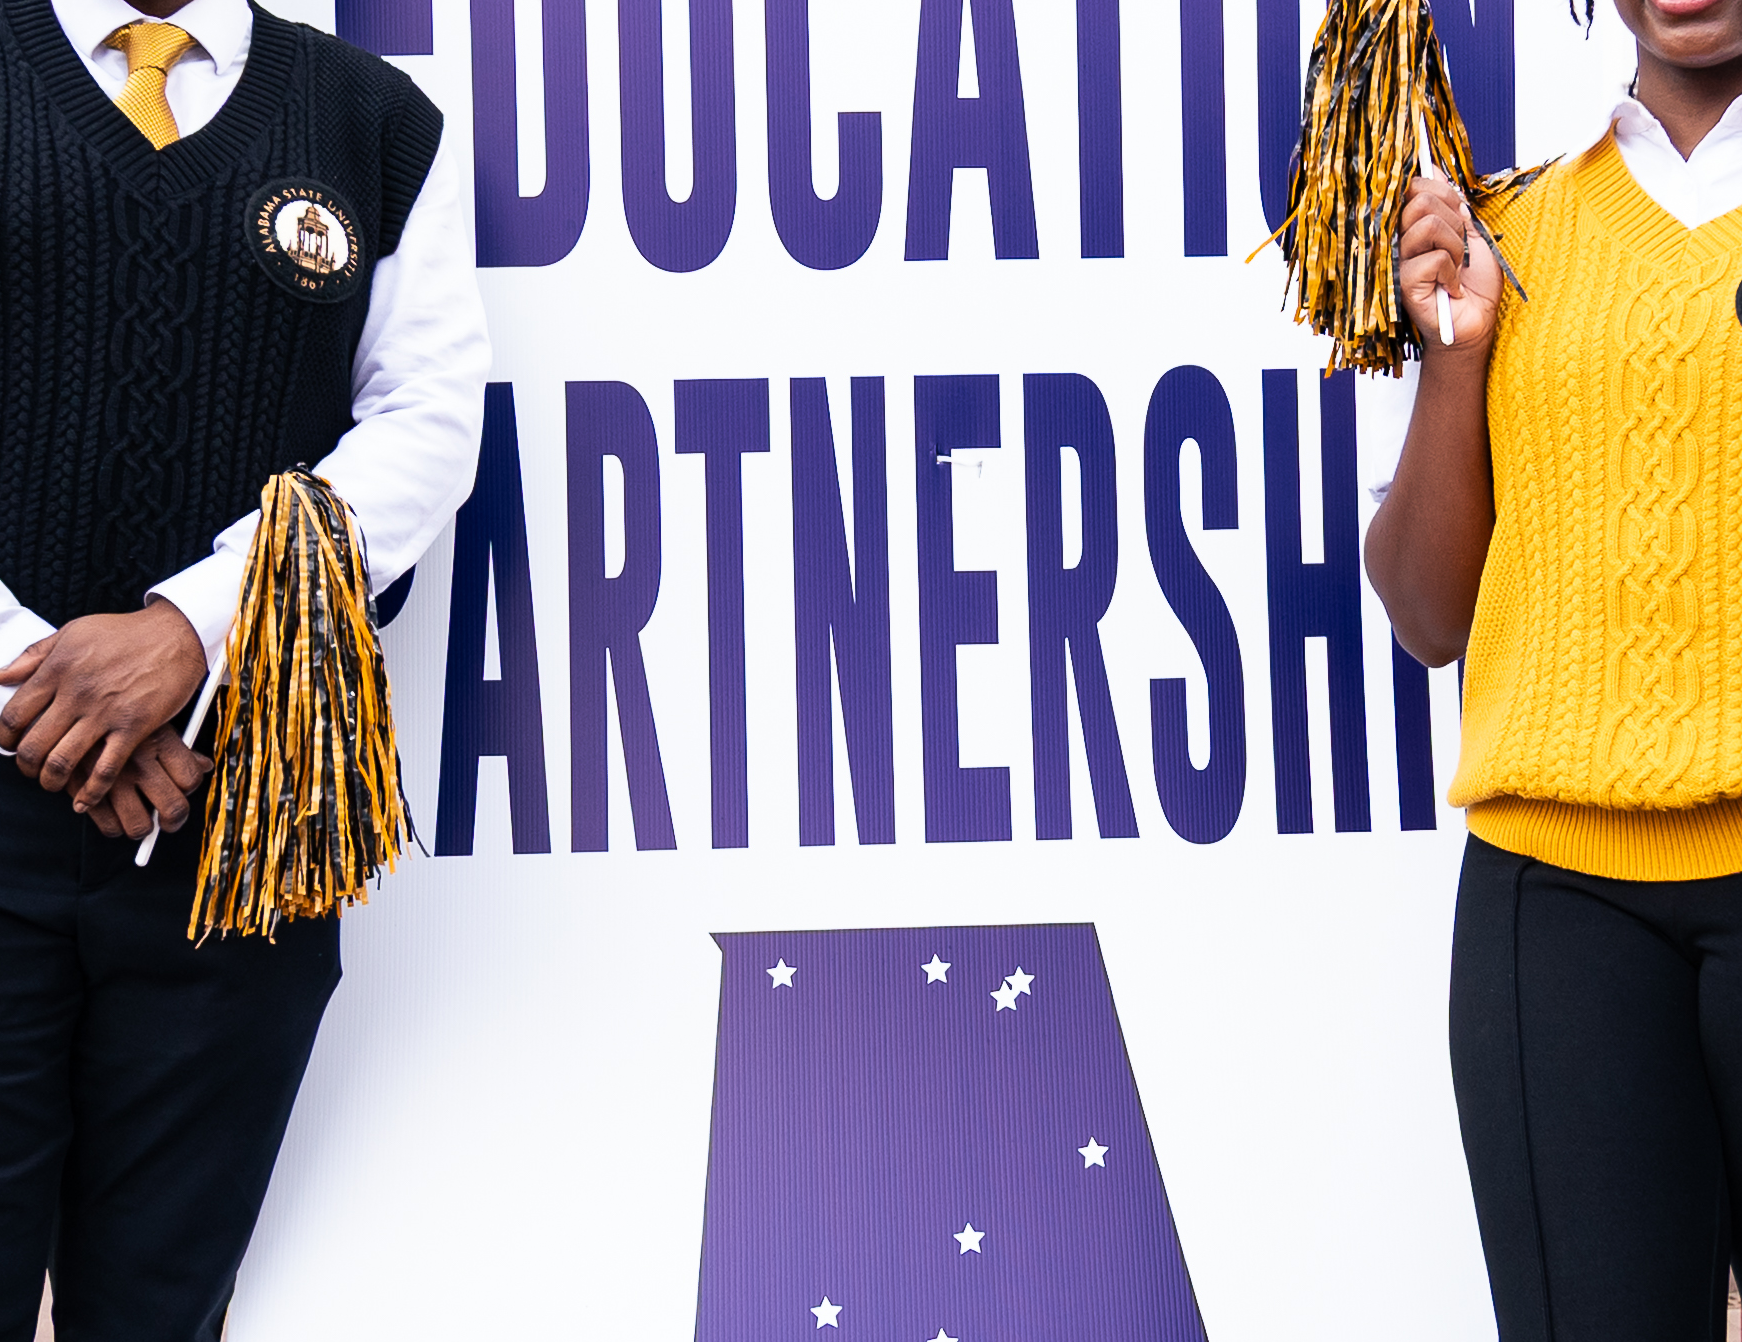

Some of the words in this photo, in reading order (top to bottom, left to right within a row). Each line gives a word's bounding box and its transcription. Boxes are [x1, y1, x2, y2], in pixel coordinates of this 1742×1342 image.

[257, 195, 282, 253] ALABAMA
[282, 187, 323, 202] STATE
[378, 365, 1464, 857] ARTNERSH
